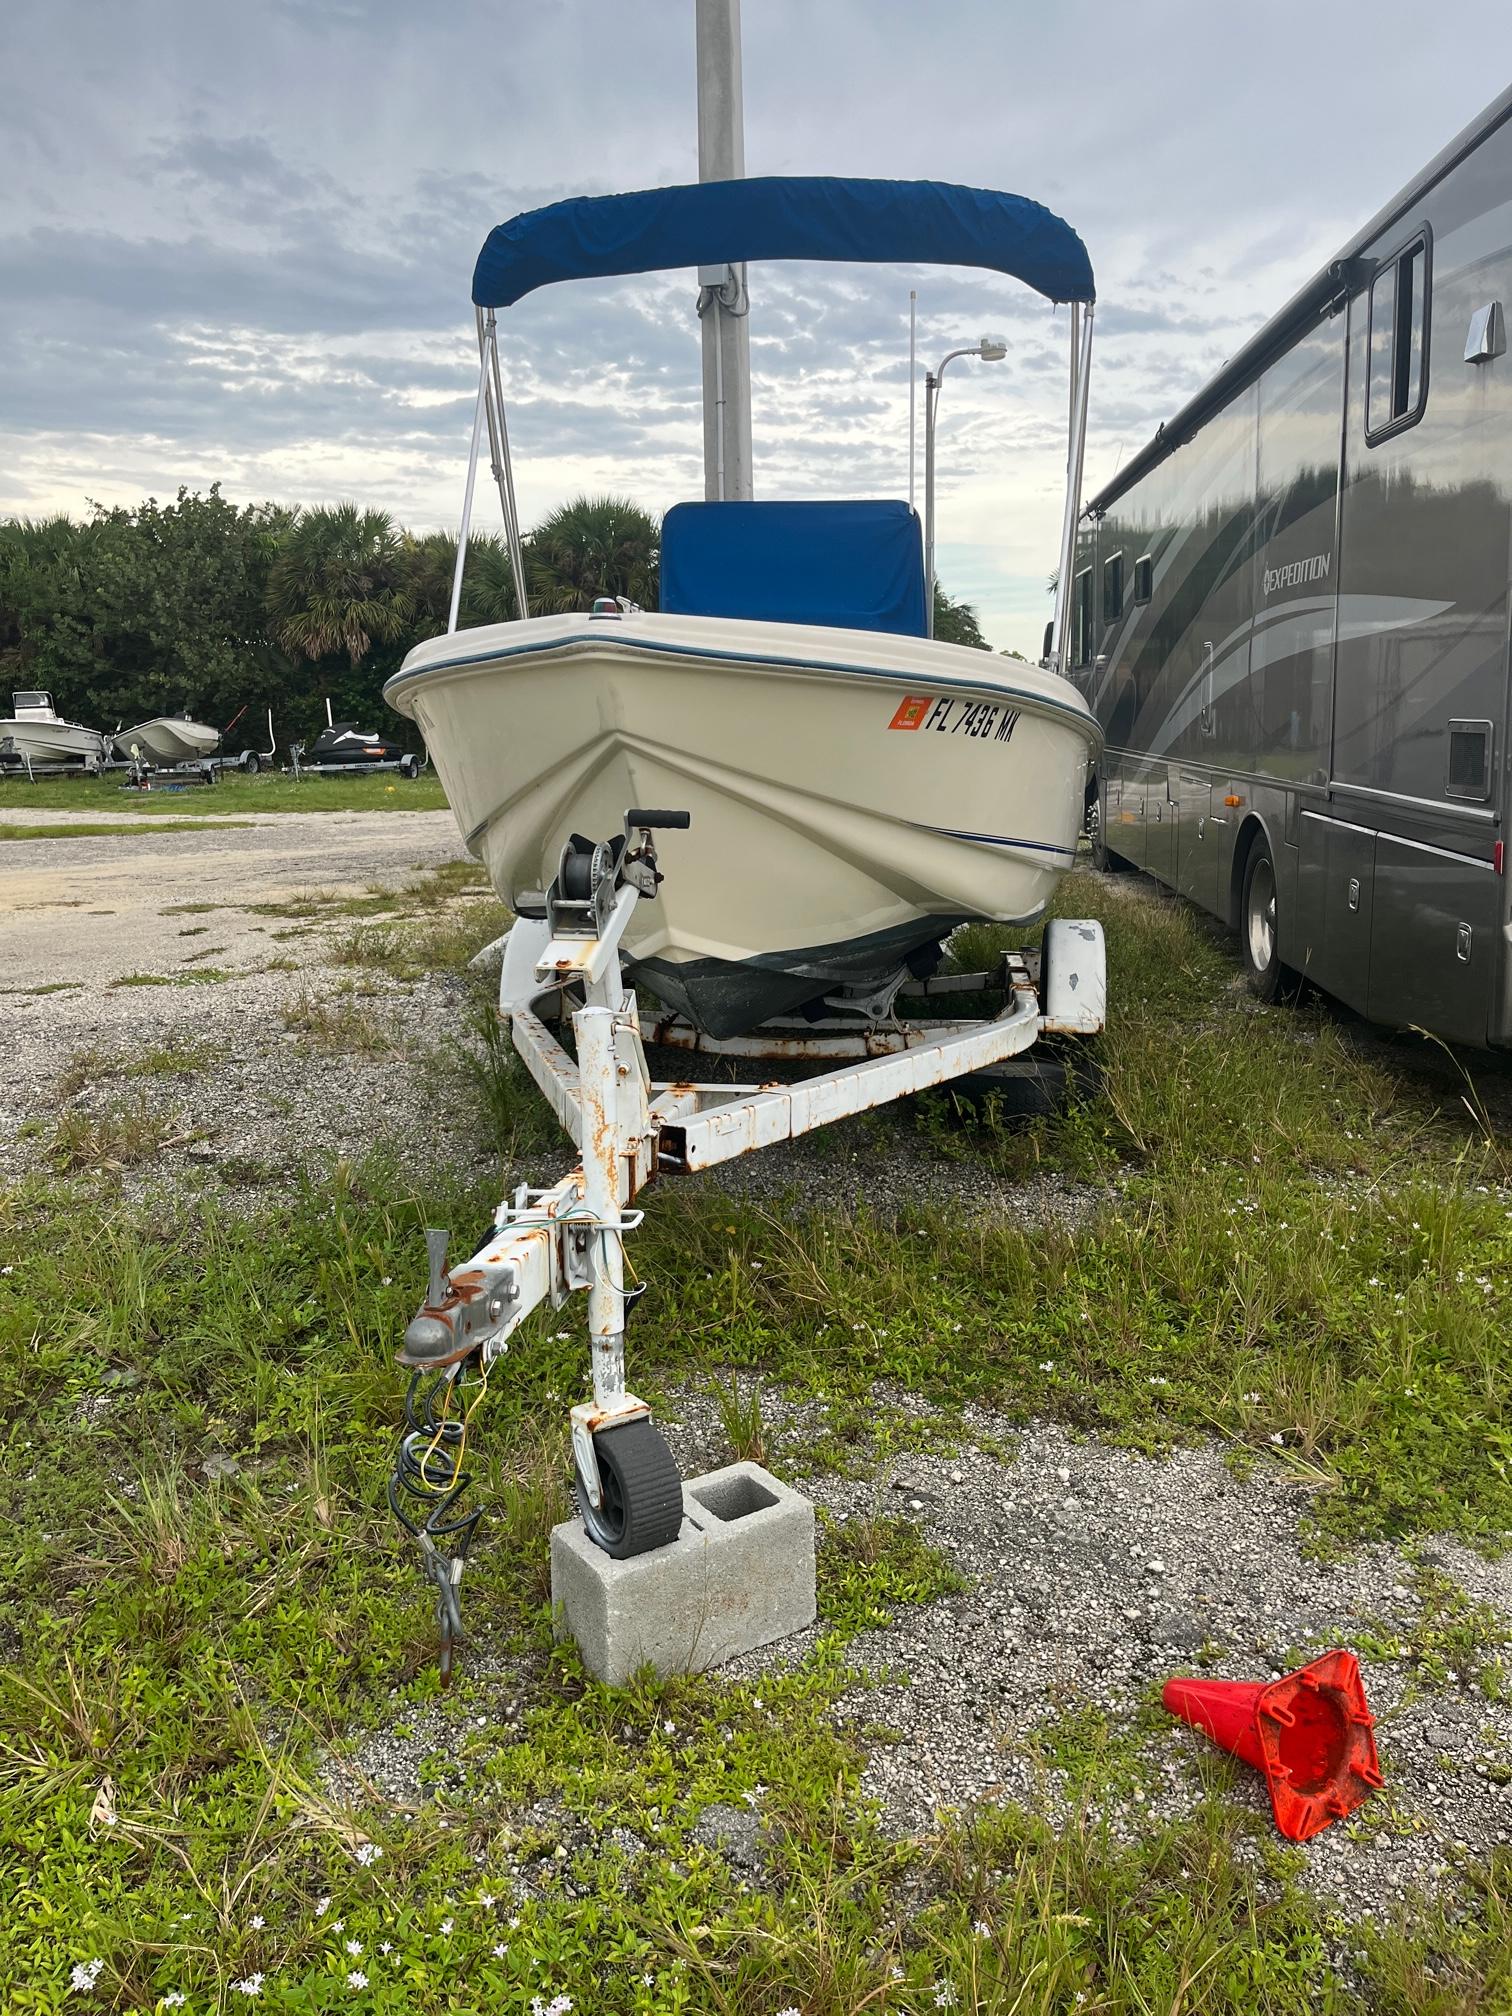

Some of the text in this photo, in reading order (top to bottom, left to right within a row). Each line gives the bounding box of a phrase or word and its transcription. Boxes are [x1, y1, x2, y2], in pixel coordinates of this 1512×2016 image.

[1269, 552, 1331, 592] EXPEDITION
[925, 698, 1022, 742] FL 7436 MK
